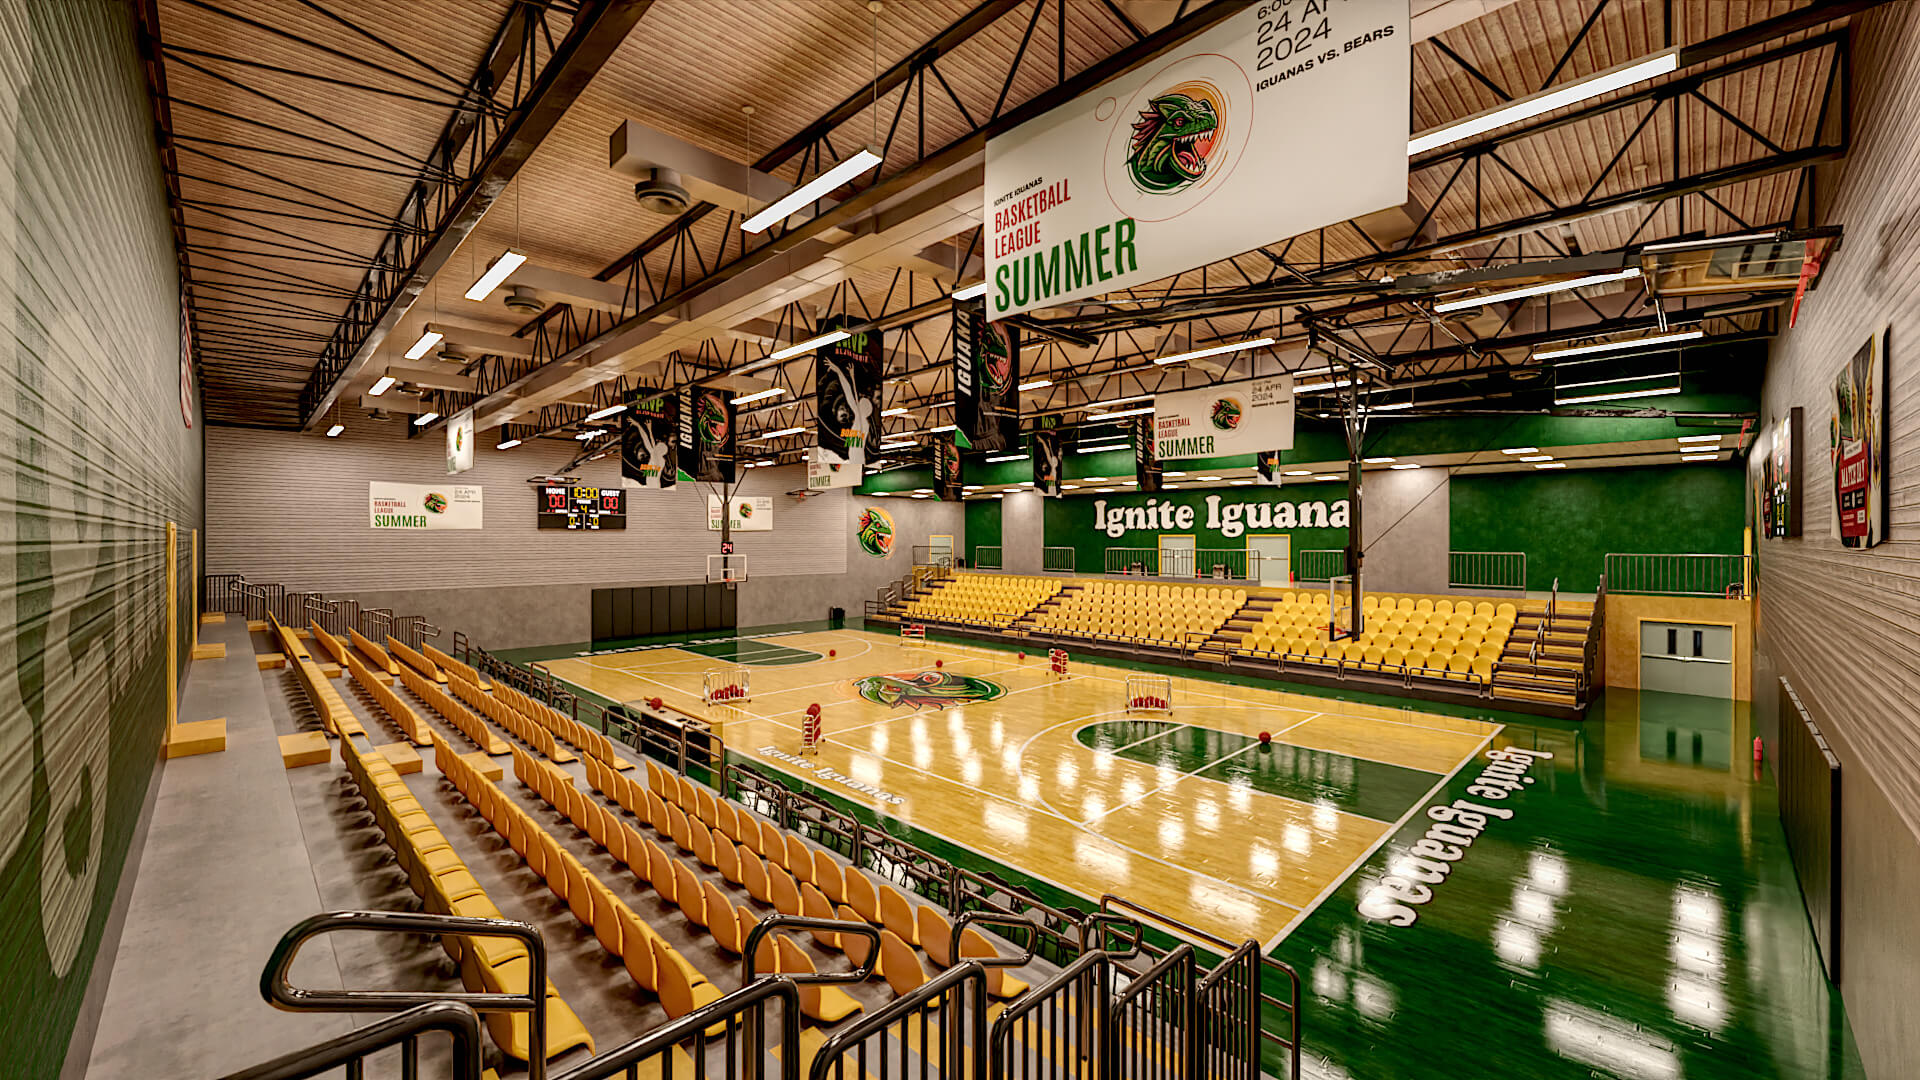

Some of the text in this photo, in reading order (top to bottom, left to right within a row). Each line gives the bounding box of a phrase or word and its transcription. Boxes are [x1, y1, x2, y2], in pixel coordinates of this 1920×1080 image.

[1257, 10, 1292, 46] 24
[1256, 17, 1332, 71] 2024
[1256, 25, 1395, 92] IGUANAS VS. BEARS
[1014, 177, 1043, 195] IGUANAS
[995, 178, 1071, 234] BASKETBALL
[995, 220, 1041, 259] LEAGUE
[995, 217, 1138, 312] SUMMER
[1265, 383, 1281, 391] APR
[679, 387, 693, 450] IGUANAS
[1158, 417, 1190, 429] BASKETBALL
[1158, 429, 1178, 439] LEAGUE
[1158, 435, 1215, 457] SUMMER
[545, 487, 566, 495] HOME
[573, 487, 599, 498] 10:00
[548, 495, 566, 508] 00
[580, 505, 588, 514] 4
[603, 496, 619, 509] 00
[375, 514, 427, 527] SUMMER
[711, 519, 741, 529] SUER
[1094, 498, 1195, 538] Ignite
[722, 542, 733, 553] 24
[756, 745, 906, 805] Ignite Iguanas
[1357, 745, 1554, 928] Ignite Iguanas
